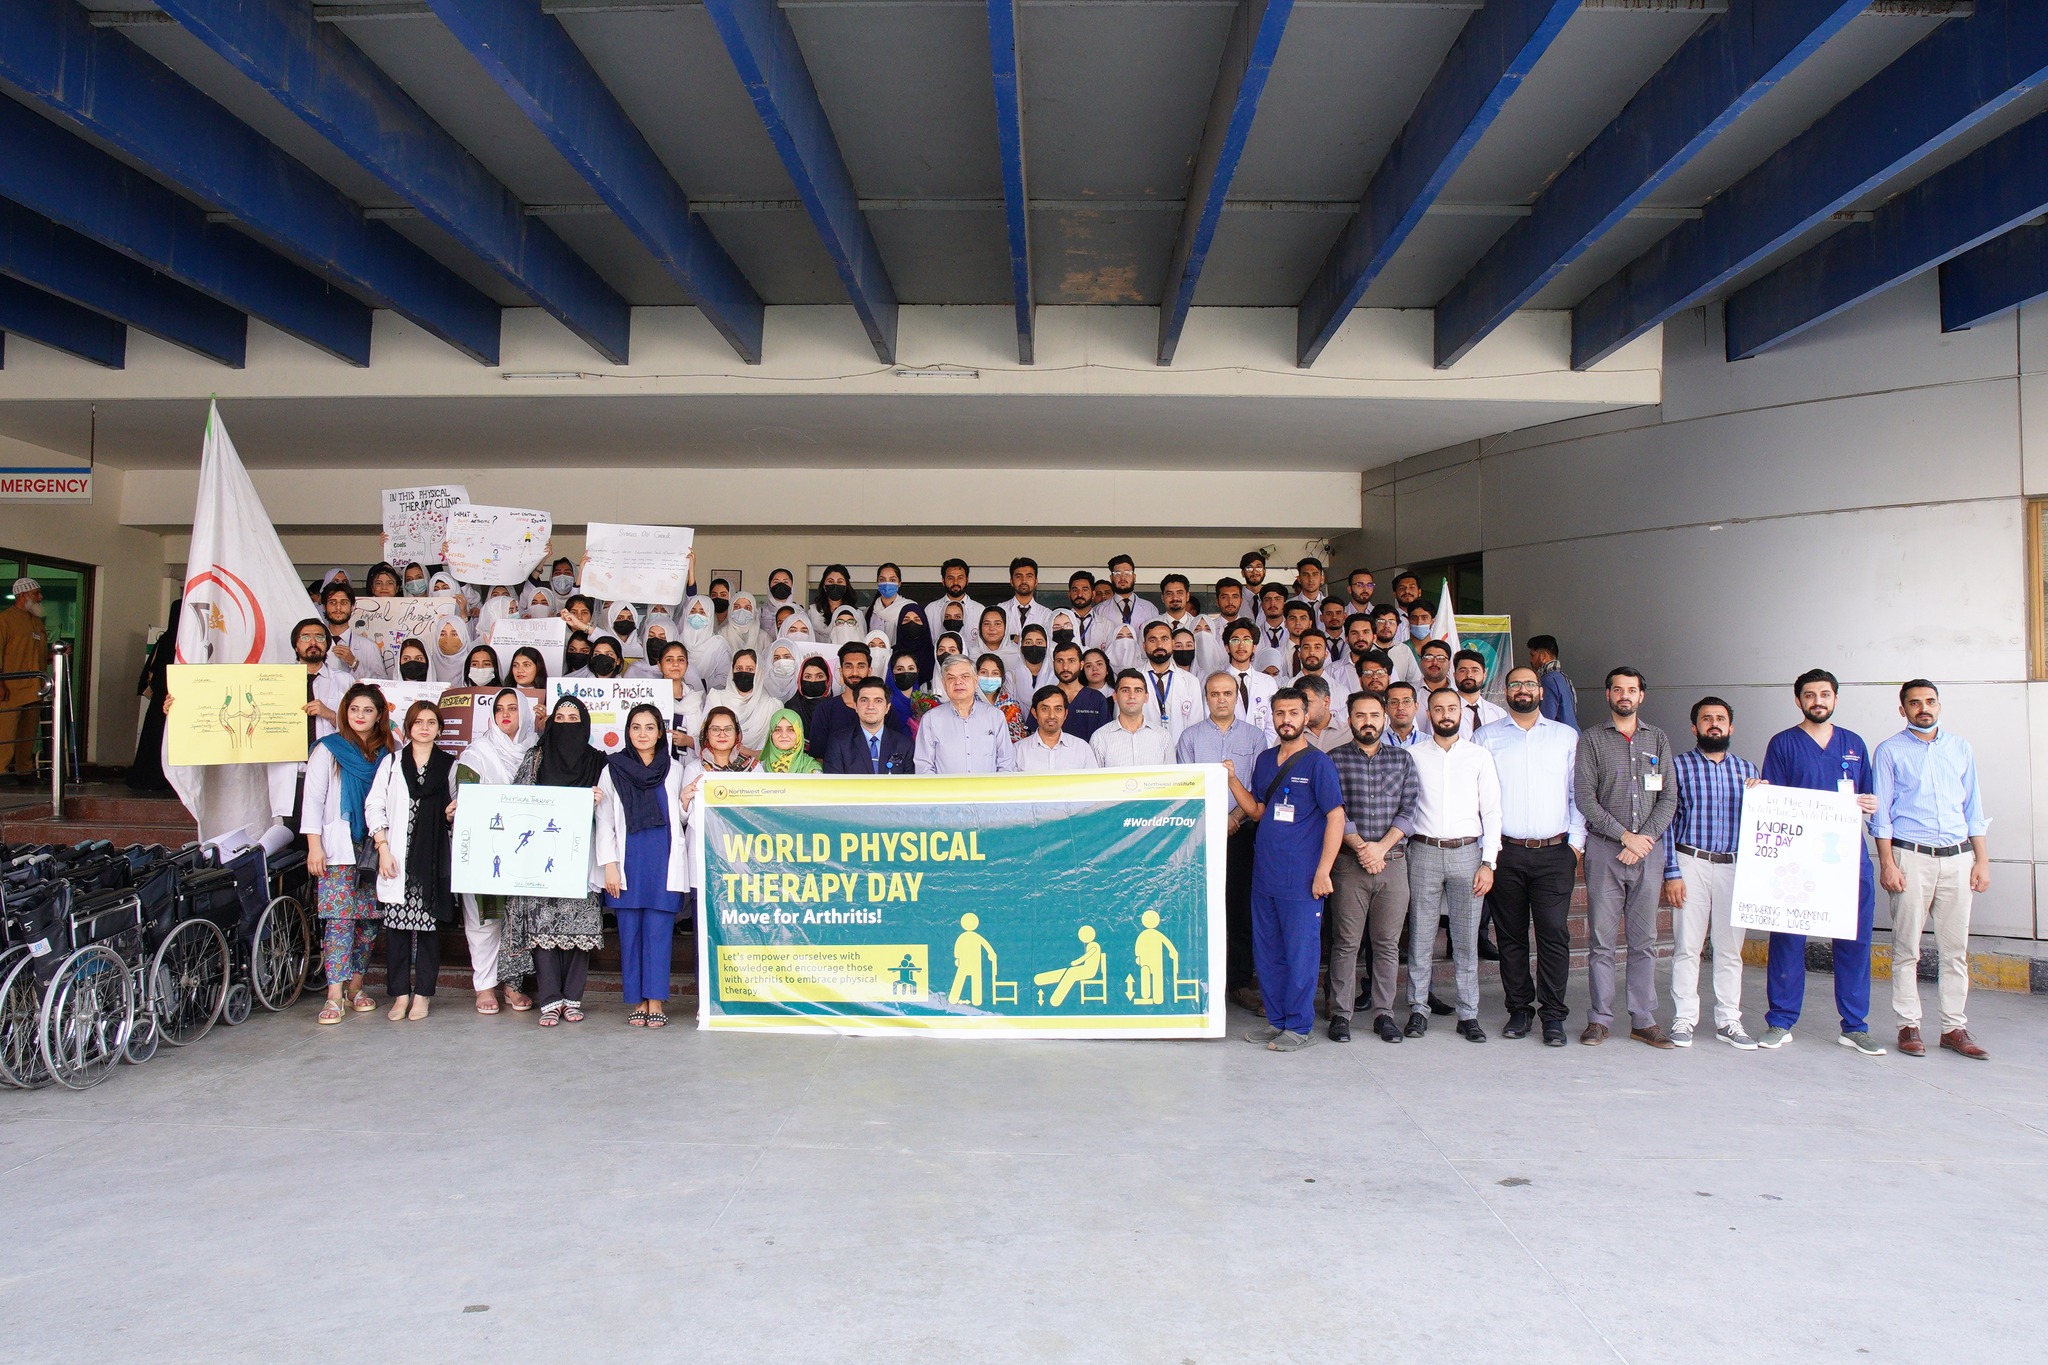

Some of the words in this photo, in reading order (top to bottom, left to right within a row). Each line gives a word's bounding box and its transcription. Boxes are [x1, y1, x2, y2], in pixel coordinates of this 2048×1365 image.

[1, 479, 88, 493] MERGENCY
[398, 491, 415, 501] THIS
[419, 488, 450, 499] PHYSICAL
[399, 500, 433, 512] THERAPY
[557, 683, 604, 698] WORLD
[612, 683, 655, 698] PHYSICAL
[583, 701, 611, 711] ERAPY
[1123, 816, 1196, 828] #WorldPTDay
[1757, 820, 1803, 836] WORLD
[461, 829, 470, 863] WORLD
[722, 833, 831, 863] WORLD
[840, 831, 986, 862] PHYSICAL
[1755, 832, 1771, 845] PT
[1775, 834, 1794, 848] DAY
[1754, 845, 1779, 859] 2023
[722, 873, 858, 903] THERAPY
[868, 872, 924, 902] DAY
[721, 909, 770, 925] Move
[773, 909, 799, 924] for
[803, 908, 882, 925] Arthritis!
[1741, 912, 1780, 927] RESTORING
[723, 952, 745, 961] Let's
[746, 953, 790, 963] empower
[792, 952, 838, 961] ourselves
[839, 952, 861, 961] with
[723, 964, 774, 973] knowledge
[775, 964, 792, 972] and
[795, 965, 844, 974] encourage
[846, 963, 873, 972] those
[724, 975, 743, 984] with
[744, 975, 783, 984] arthritis
[785, 976, 795, 984] to
[797, 975, 838, 984] embrace
[839, 974, 878, 985] physical
